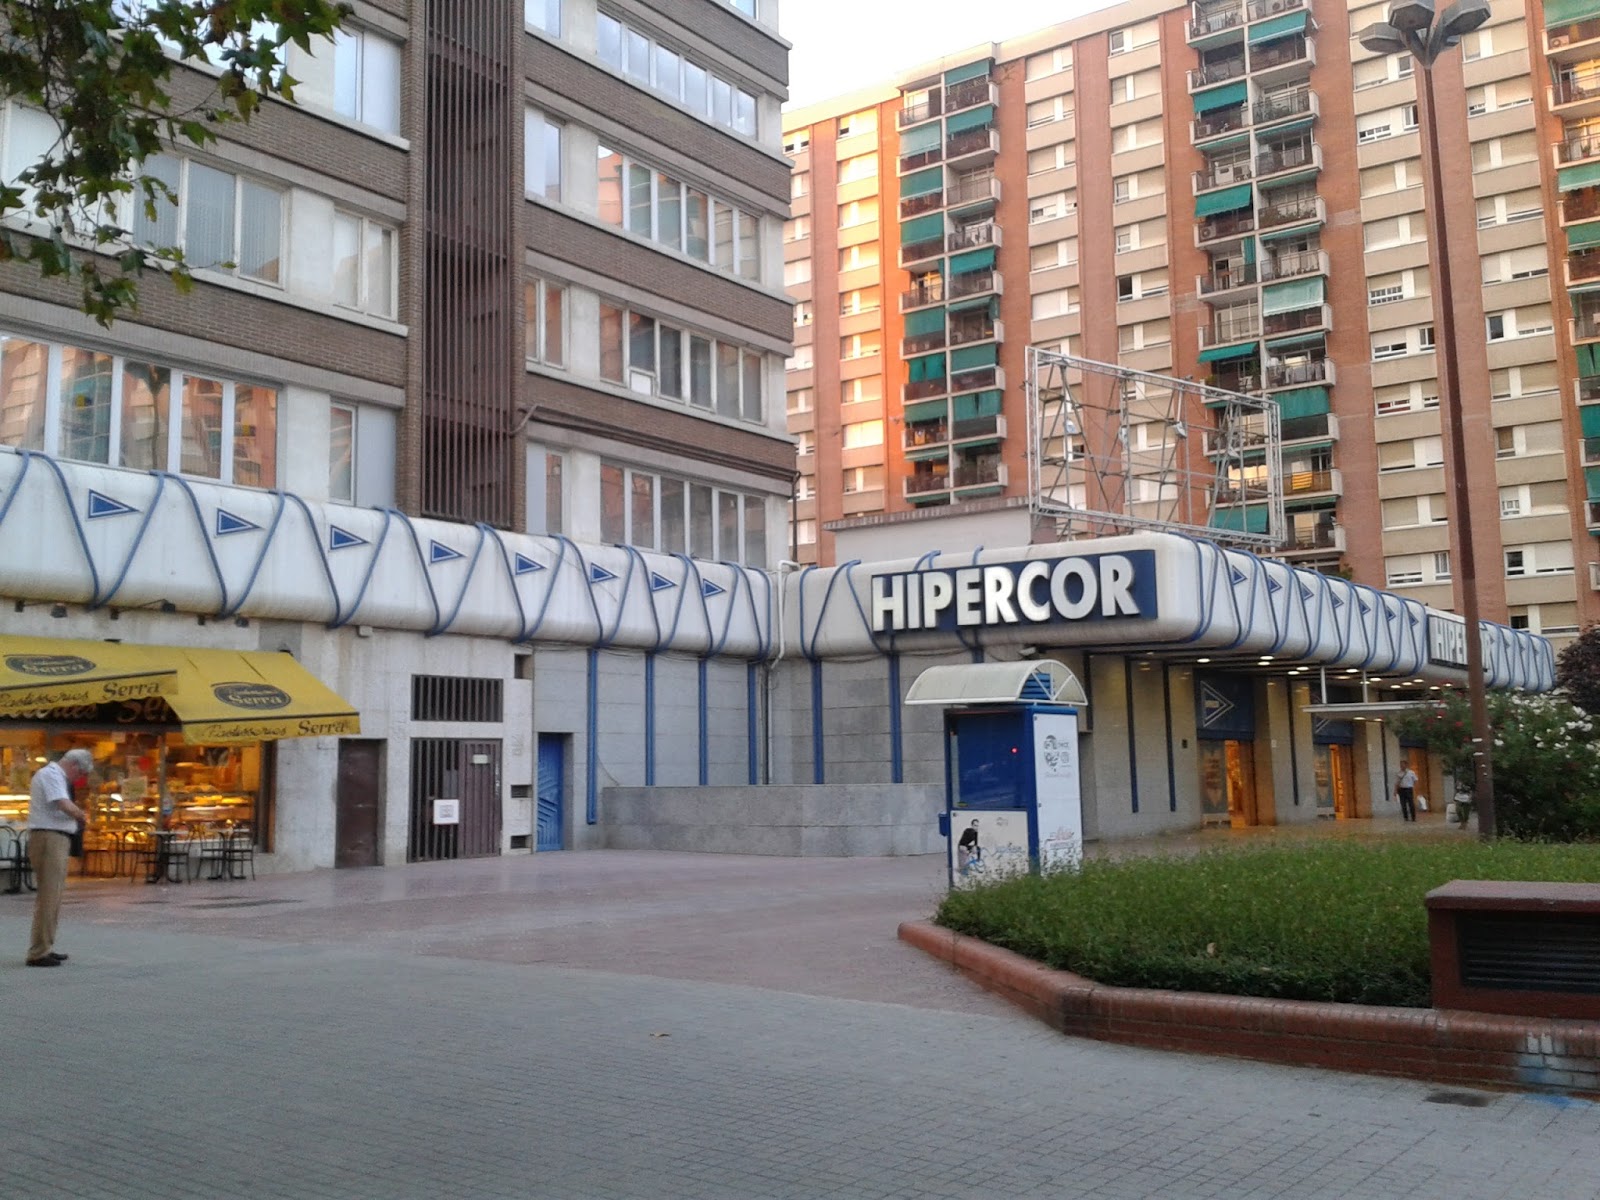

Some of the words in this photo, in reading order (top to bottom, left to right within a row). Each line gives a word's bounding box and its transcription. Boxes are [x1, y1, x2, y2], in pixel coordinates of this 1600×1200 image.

[871, 555, 1140, 632] HIPERCOR
[102, 681, 160, 700] Serra
[228, 693, 283, 706] Serra
[298, 719, 347, 737] Serra
